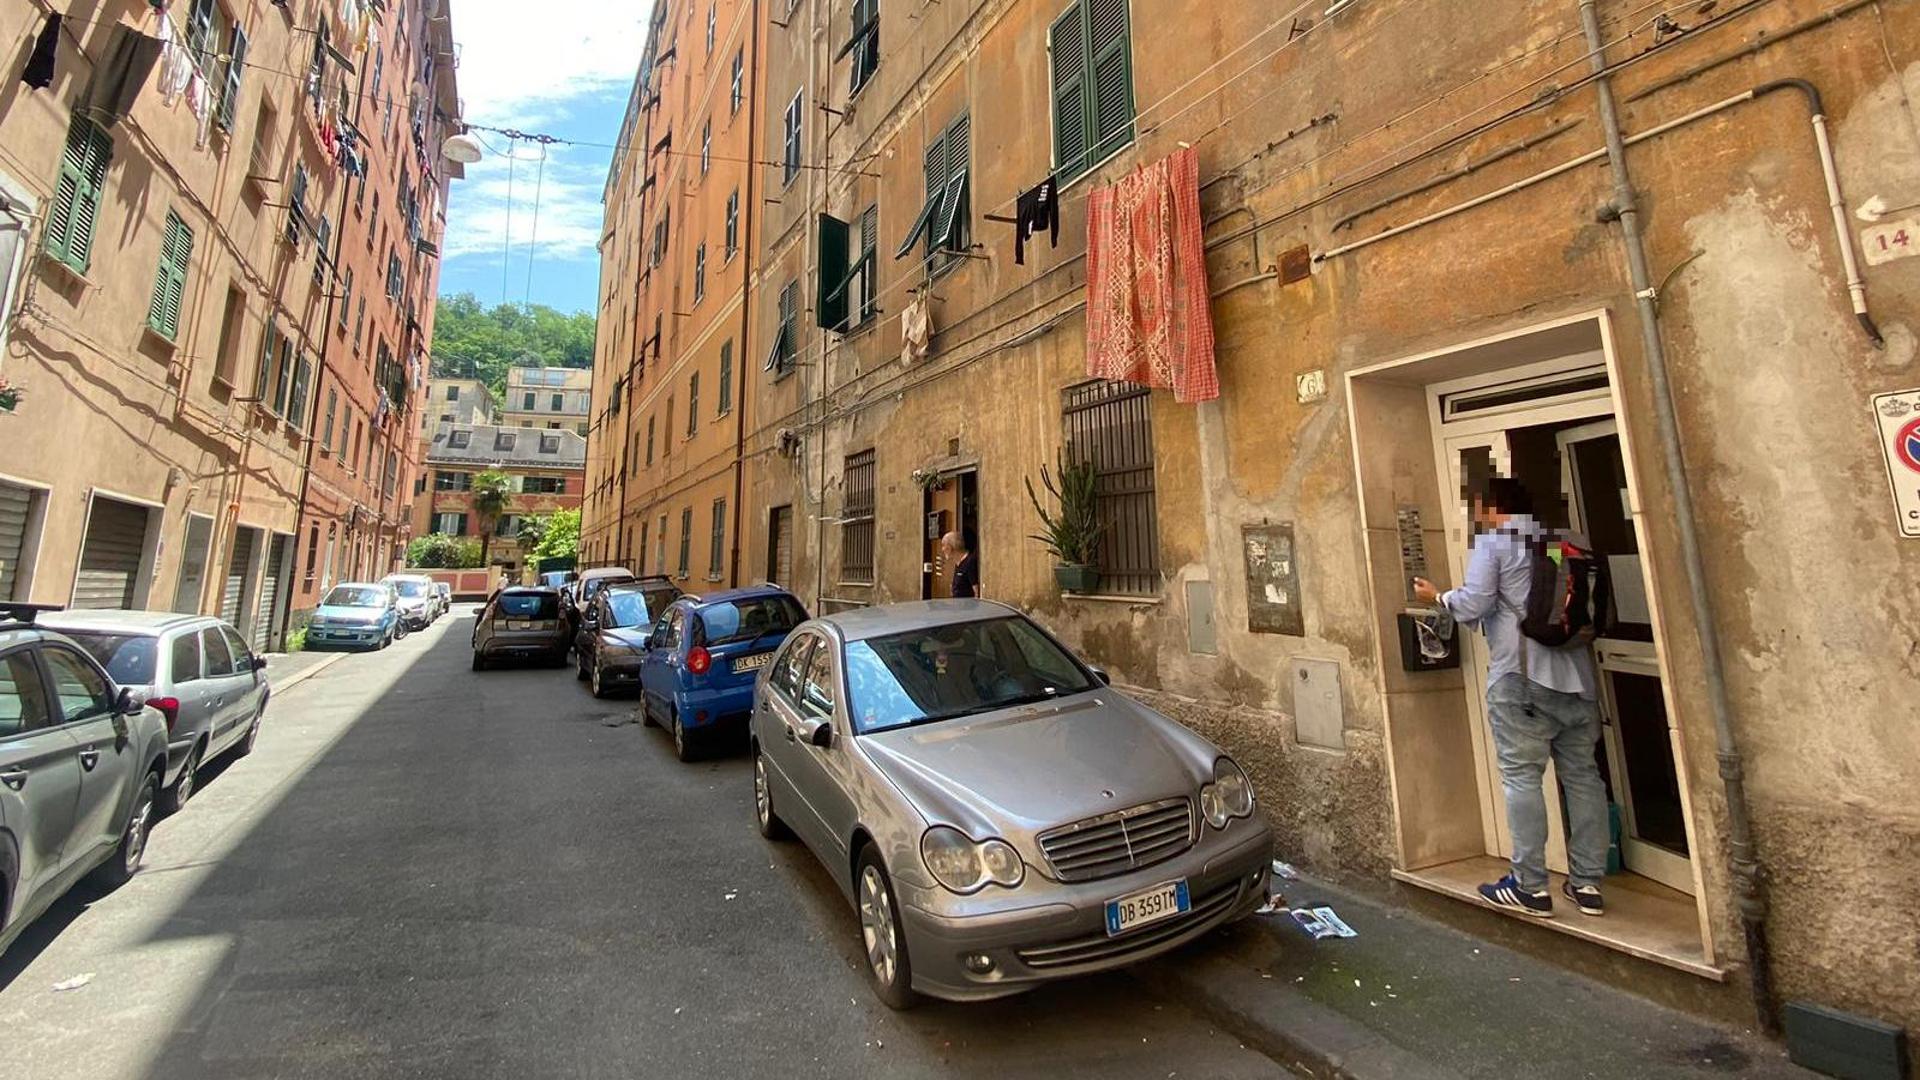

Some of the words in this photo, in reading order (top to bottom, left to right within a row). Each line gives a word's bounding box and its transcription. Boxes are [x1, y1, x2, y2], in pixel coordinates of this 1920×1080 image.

[1876, 229, 1909, 250] 14
[1119, 903, 1136, 925] DB
[1138, 889, 1177, 918] 359TM
